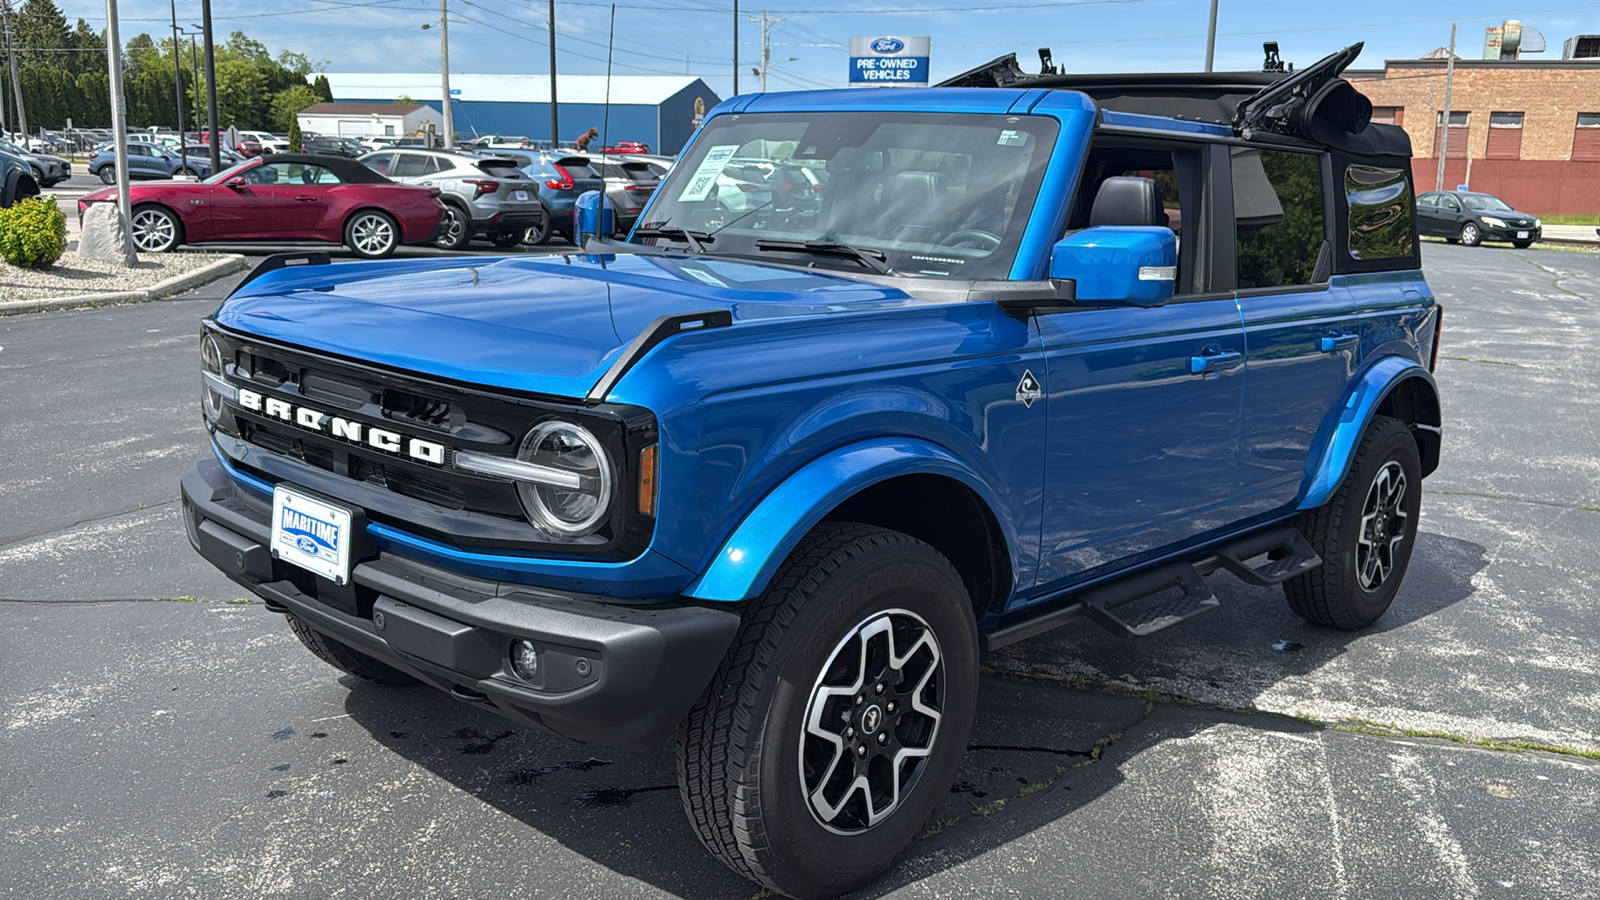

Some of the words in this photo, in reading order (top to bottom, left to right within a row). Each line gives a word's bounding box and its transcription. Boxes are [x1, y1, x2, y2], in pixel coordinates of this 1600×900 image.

[876, 41, 897, 51] Ford
[863, 70, 911, 80] VEHICLES
[239, 388, 445, 465] BRONCO
[282, 508, 338, 550] MARITIME
[299, 539, 316, 554] Ford
[805, 562, 962, 661] BRIDGESTONE
